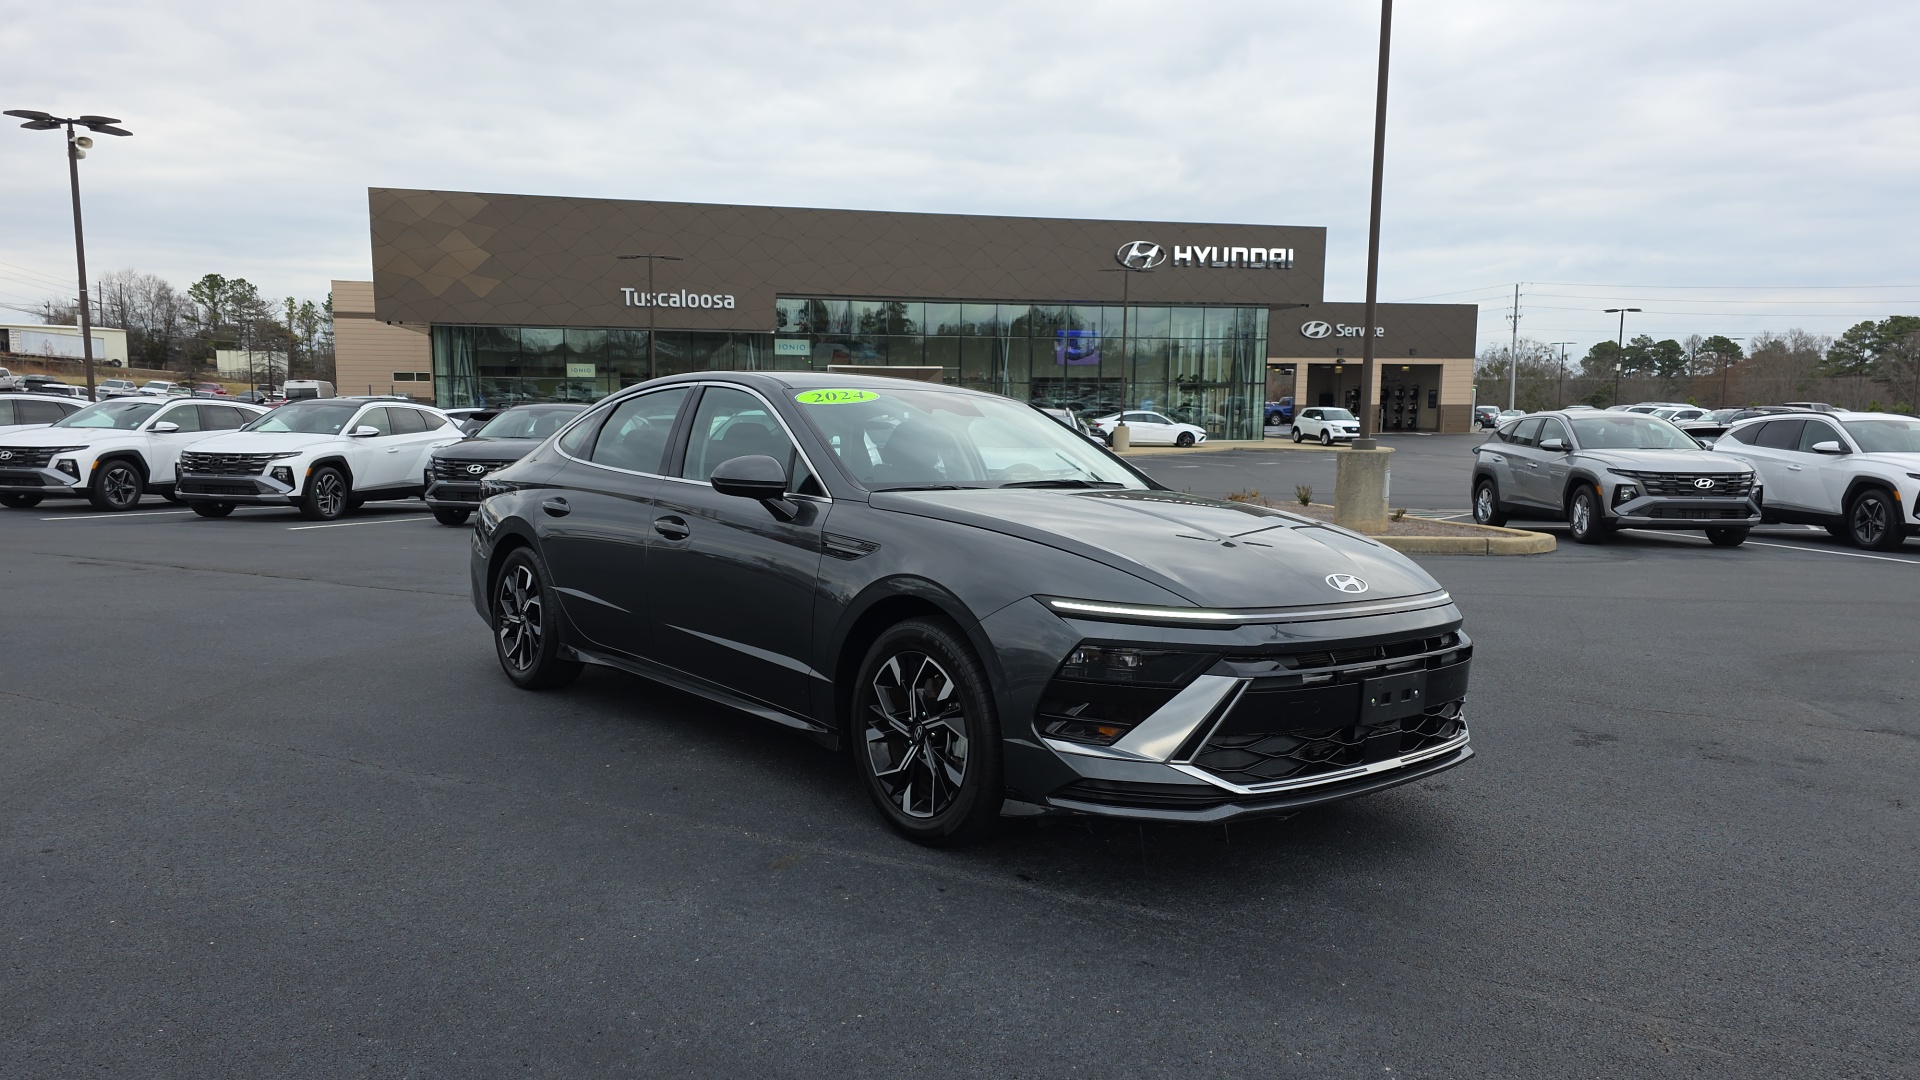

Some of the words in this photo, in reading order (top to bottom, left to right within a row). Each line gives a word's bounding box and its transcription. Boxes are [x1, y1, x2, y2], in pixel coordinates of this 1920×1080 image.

[1173, 245, 1294, 269] HYUNDAI
[620, 287, 735, 309] Tuscaloosa
[1335, 323, 1385, 337] Serve
[811, 391, 865, 403] 2024
